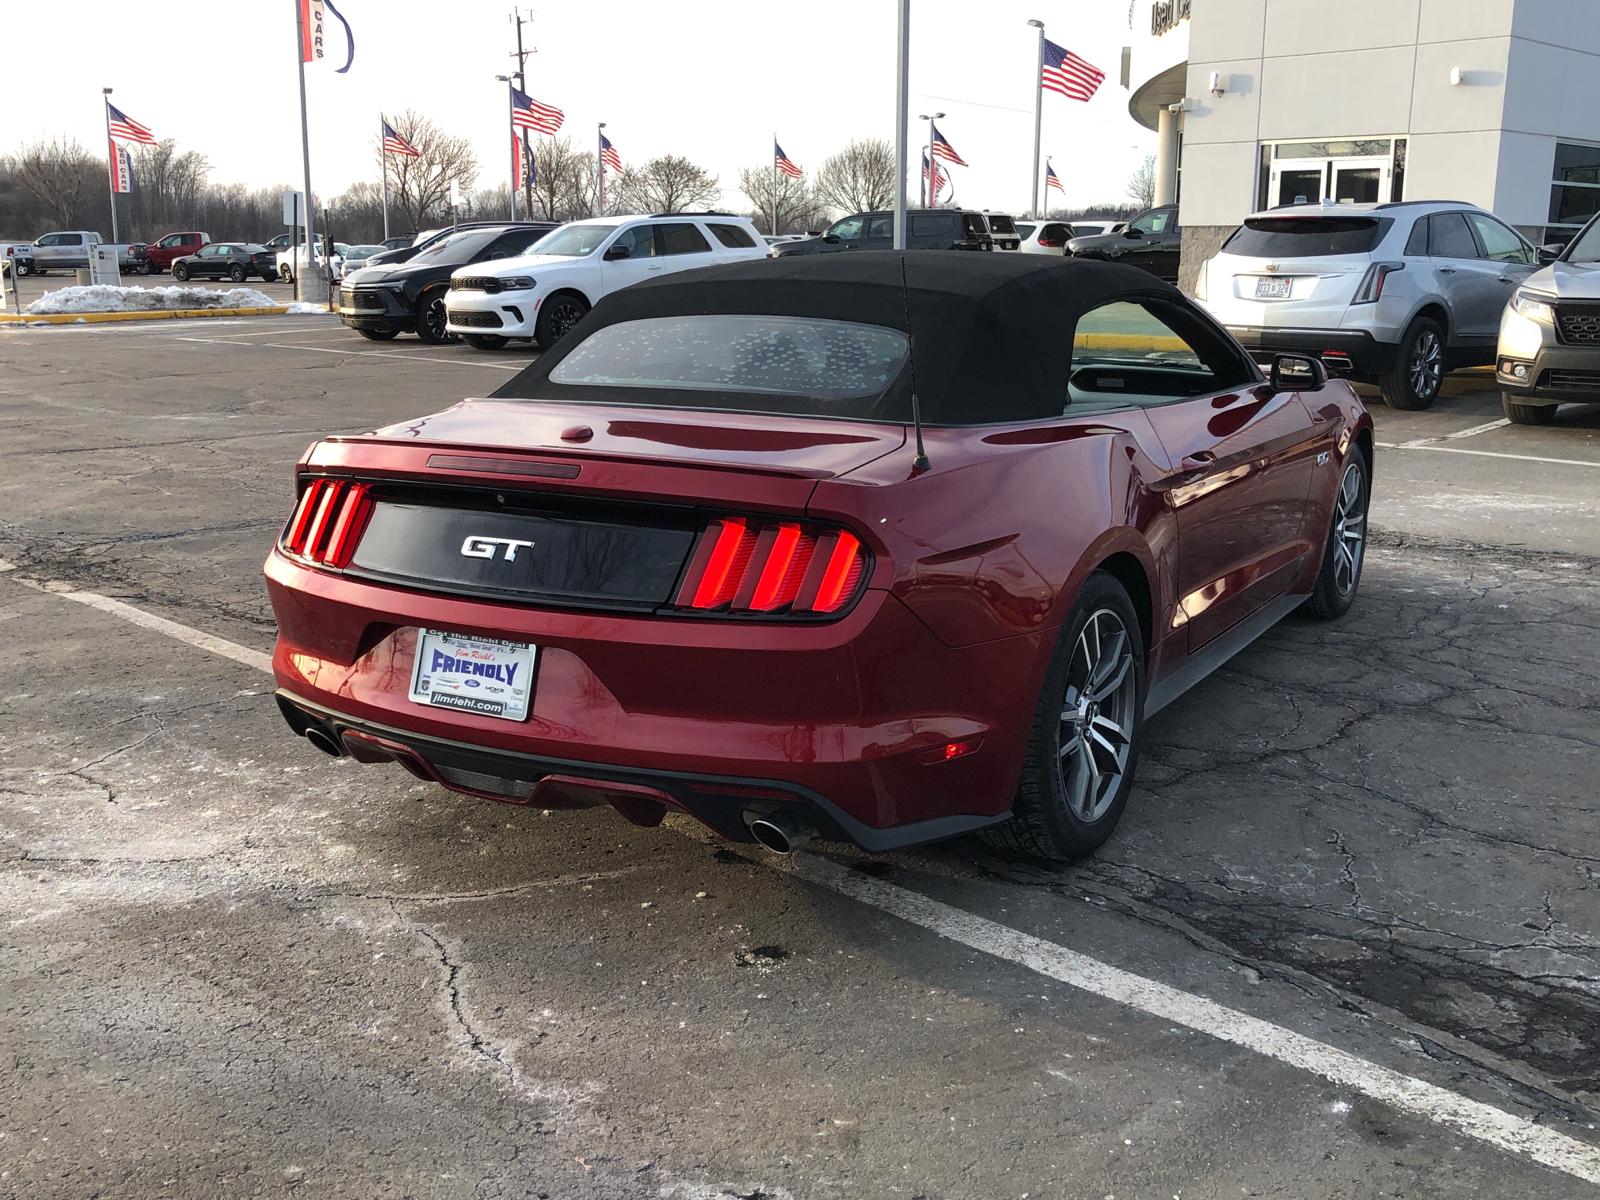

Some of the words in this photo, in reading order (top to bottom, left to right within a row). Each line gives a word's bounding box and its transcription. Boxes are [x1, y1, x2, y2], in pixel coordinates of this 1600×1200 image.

[314, 10, 324, 59] CARS
[120, 167, 128, 191] CARS
[460, 535, 536, 563] GT
[429, 629, 448, 637] Get
[451, 632, 468, 640] the
[471, 635, 499, 645] Riehl
[501, 640, 525, 648] Deal
[454, 648, 469, 657] Jim
[471, 651, 495, 661] Riehl's
[430, 648, 520, 687] FRIENDLY
[432, 693, 502, 713] jimriehl.com
